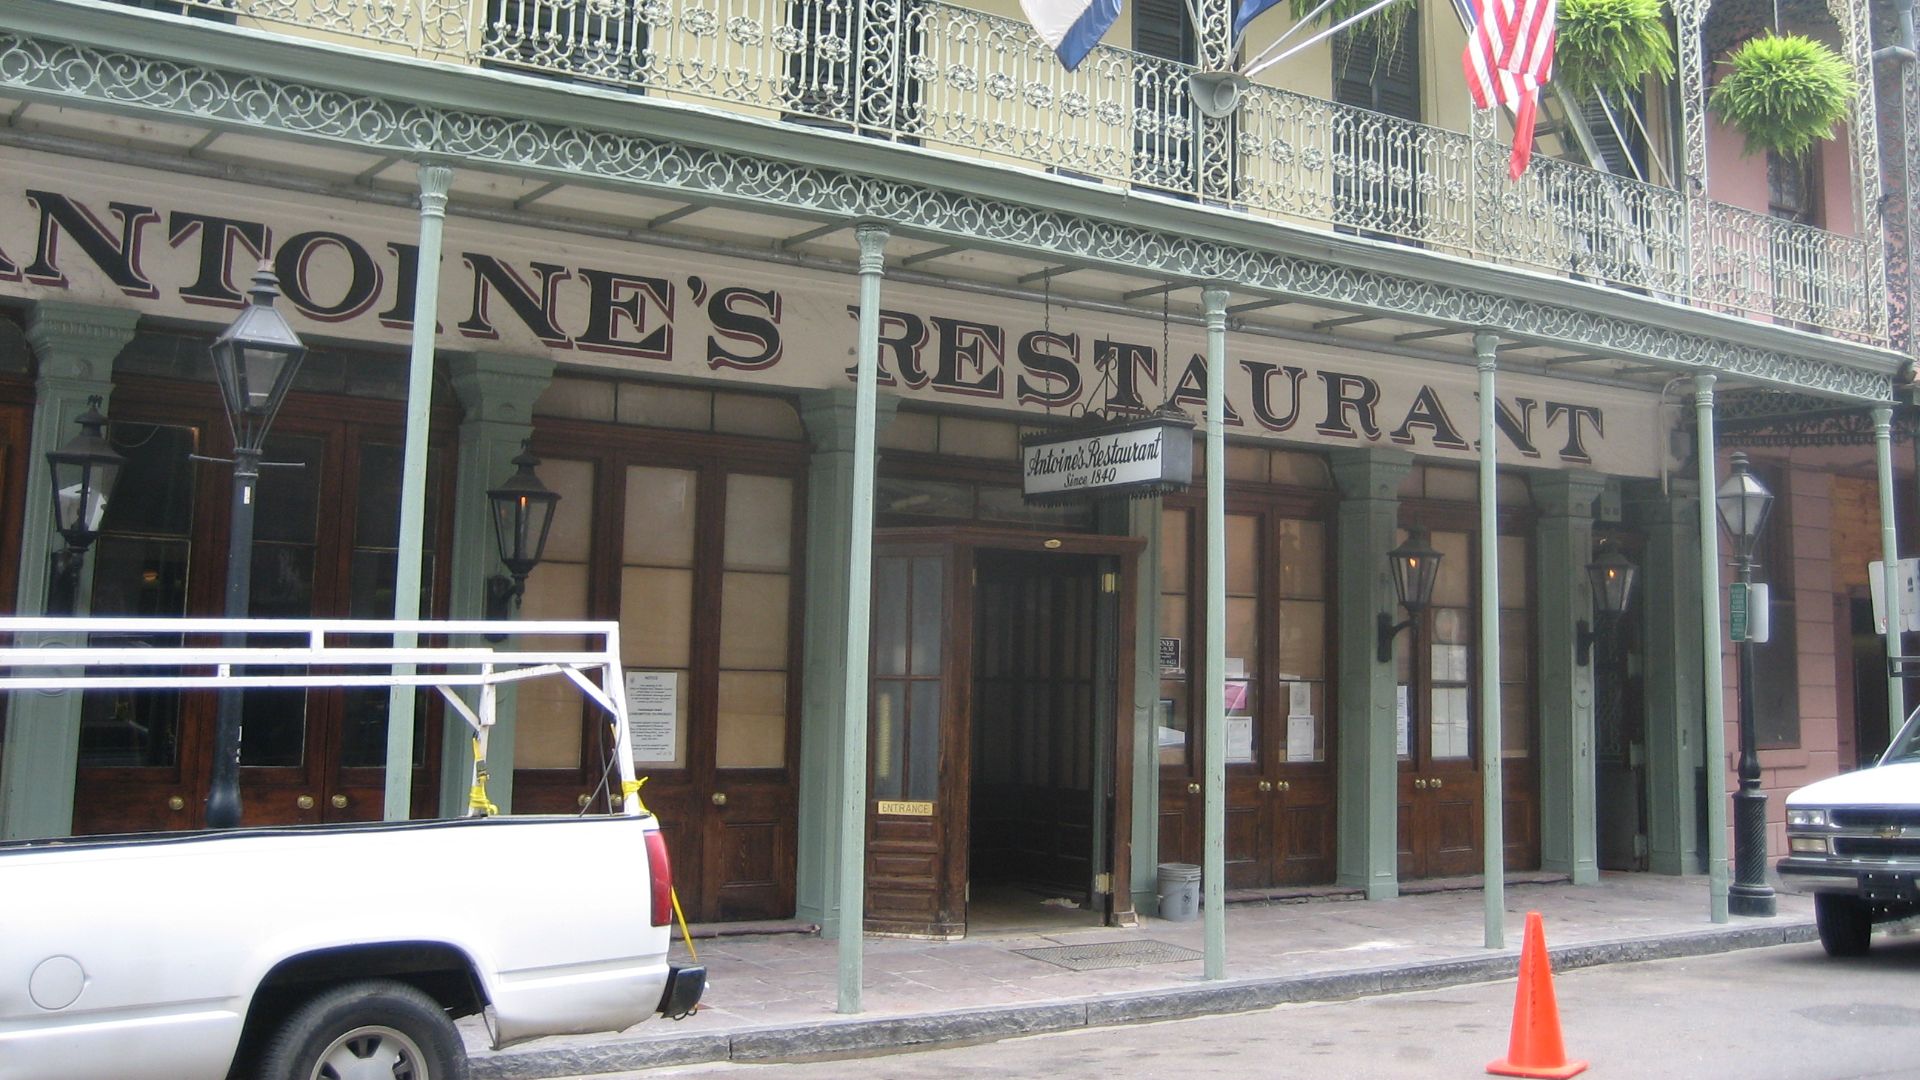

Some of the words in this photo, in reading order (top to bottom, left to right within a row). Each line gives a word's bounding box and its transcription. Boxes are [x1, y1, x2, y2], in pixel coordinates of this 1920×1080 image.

[0, 189, 783, 371] NTOINE'S
[845, 304, 1604, 465] RESTAURANT
[1028, 446, 1085, 476] Antoine's
[1086, 432, 1162, 468] Restaurant
[1063, 473, 1088, 488] Since
[1090, 468, 1117, 484] 1840
[883, 803, 930, 814] ENTRANCE
